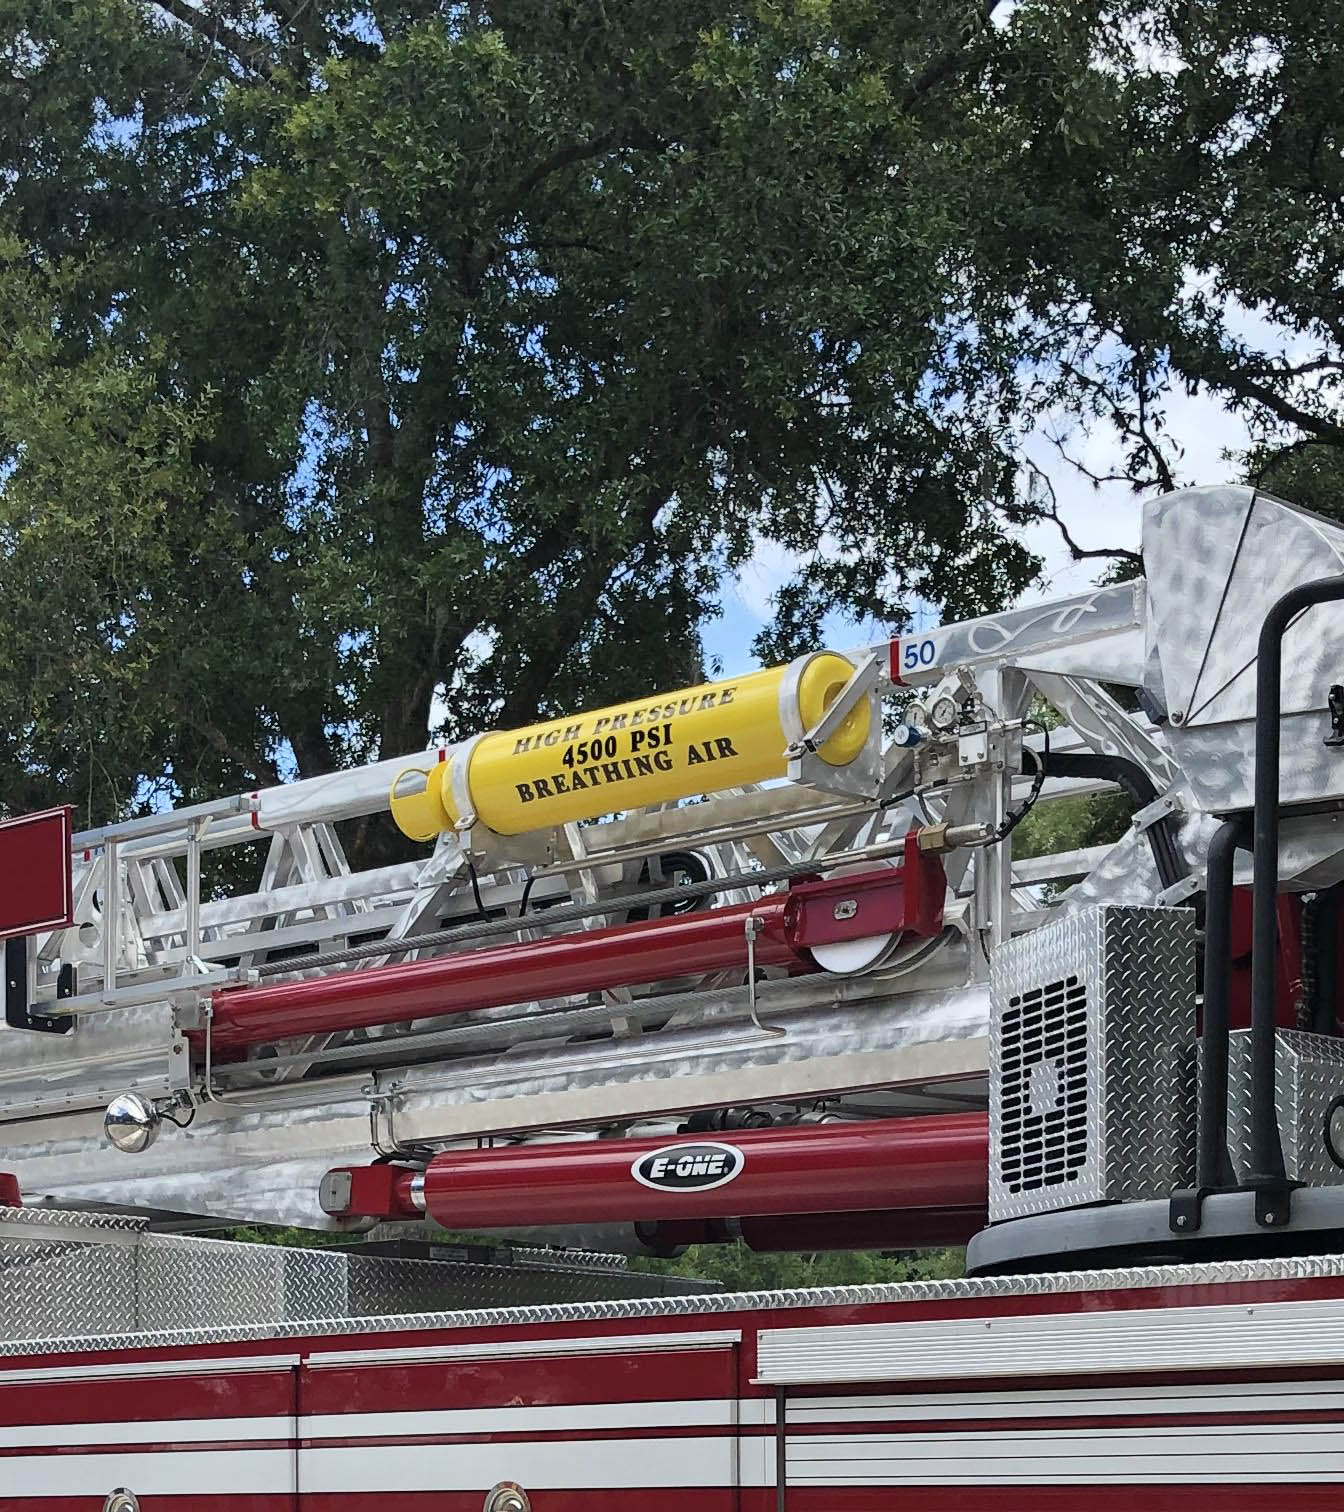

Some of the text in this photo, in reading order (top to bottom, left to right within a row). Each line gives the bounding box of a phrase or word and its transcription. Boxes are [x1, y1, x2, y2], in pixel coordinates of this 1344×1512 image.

[903, 640, 936, 670] 50
[512, 686, 739, 755] HIGH PRESSURE
[561, 722, 674, 769] 4500 PSI
[515, 737, 740, 804] BREATHING AIR
[649, 1153, 727, 1179] E-ONE
